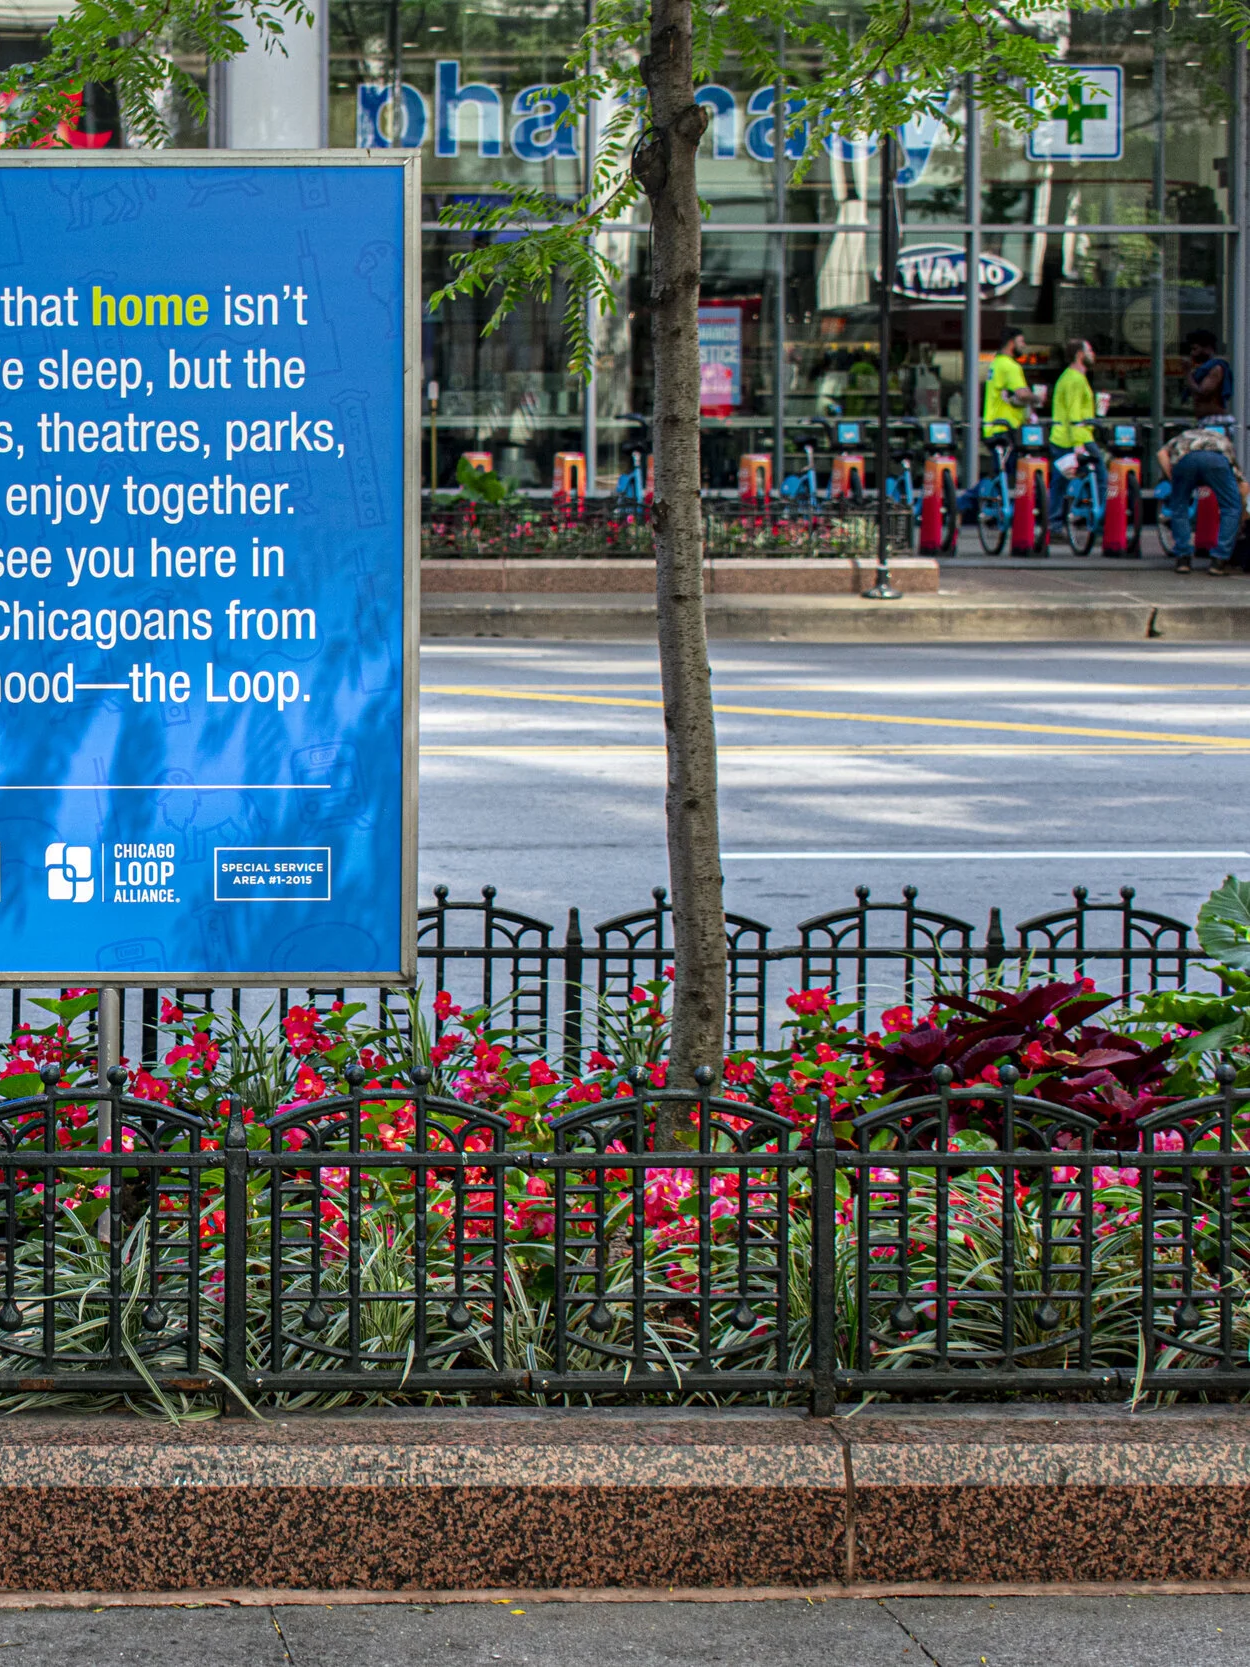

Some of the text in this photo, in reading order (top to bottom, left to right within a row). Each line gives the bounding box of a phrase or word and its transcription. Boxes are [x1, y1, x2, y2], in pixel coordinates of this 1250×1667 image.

[0, 286, 79, 327] that
[92, 285, 209, 326] home
[224, 284, 308, 326] isn’t
[38, 349, 153, 399] sleep,
[169, 348, 232, 389] but
[243, 348, 306, 389] the
[698, 345, 739, 364] STICE
[37, 412, 210, 459] theatres,
[226, 411, 345, 461] parks,
[346, 405, 377, 521] CHICAGO
[6, 475, 111, 526] enjoy
[122, 474, 294, 526] together.
[65, 546, 134, 587] you
[151, 537, 237, 578] here
[252, 537, 284, 577] in
[225, 599, 316, 641] from
[206, 662, 311, 712] Loop.
[113, 843, 175, 859] CHICAGO
[221, 863, 324, 873] SPECIAL SERVICE
[114, 861, 175, 886] LOOP
[233, 875, 313, 885] AREA #1-2015
